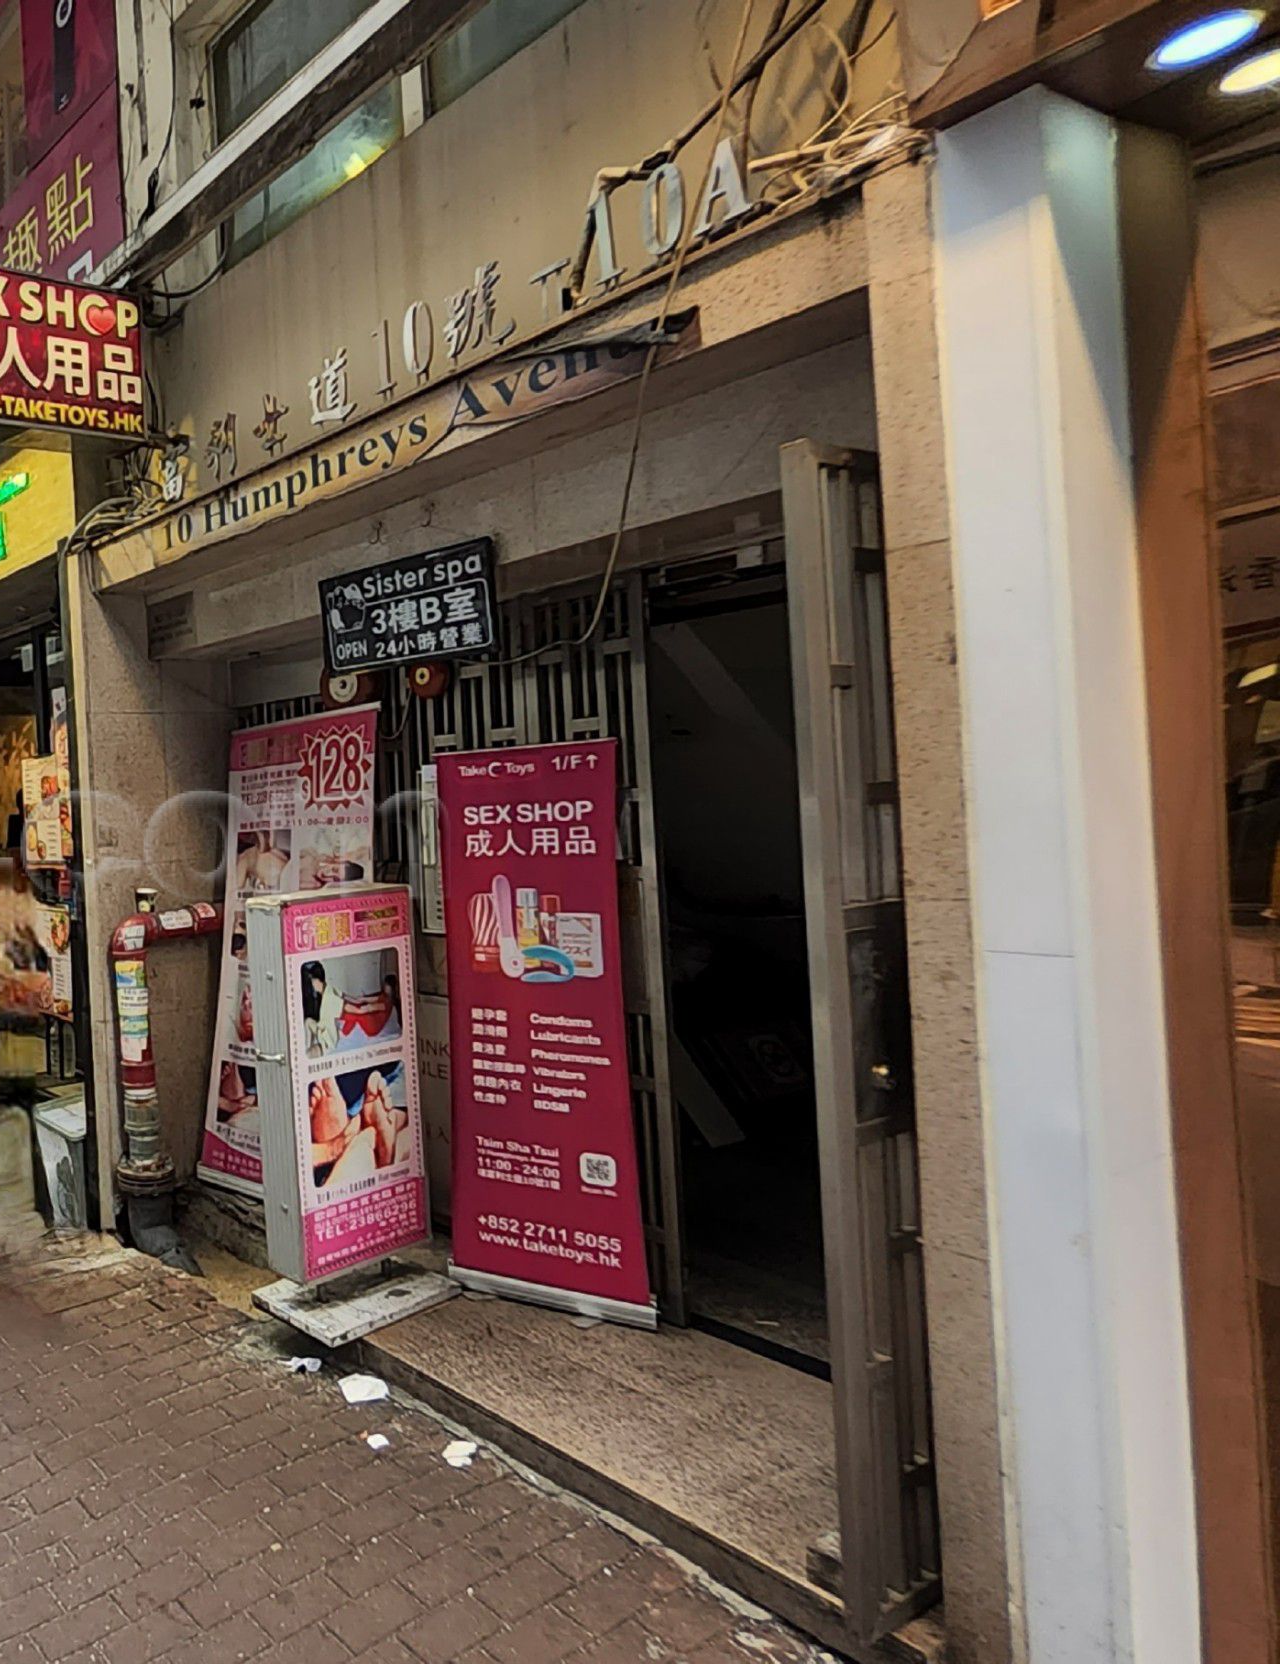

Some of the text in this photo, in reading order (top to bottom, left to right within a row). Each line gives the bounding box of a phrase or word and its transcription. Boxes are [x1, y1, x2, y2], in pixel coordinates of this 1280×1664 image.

[19, 281, 139, 338] SHOP
[163, 512, 192, 551] 10
[204, 412, 428, 536] Humphreys
[363, 553, 482, 599] Sister spa
[371, 587, 480, 635] 3樓B室
[336, 639, 368, 661] OPEN
[375, 622, 483, 659] 24小時營業
[458, 765, 487, 777] Take
[504, 762, 535, 776] Toys
[551, 755, 582, 772] 1/F
[464, 800, 594, 826] SEX SHOP
[465, 826, 597, 858] 成人用品
[530, 1013, 593, 1029] Condoms
[530, 1030, 602, 1046] Lubricants
[531, 1048, 612, 1066] Pheromones
[532, 1066, 587, 1081] Vibrators
[532, 1083, 587, 1099] Lingerie
[475, 1135, 559, 1158] Tsim Sha Tsui
[478, 1156, 511, 1171] 11:00
[522, 1163, 560, 1179] 24:00
[478, 1214, 622, 1252] +852 2711 5055
[479, 1231, 622, 1269] www.taketoys.hk
